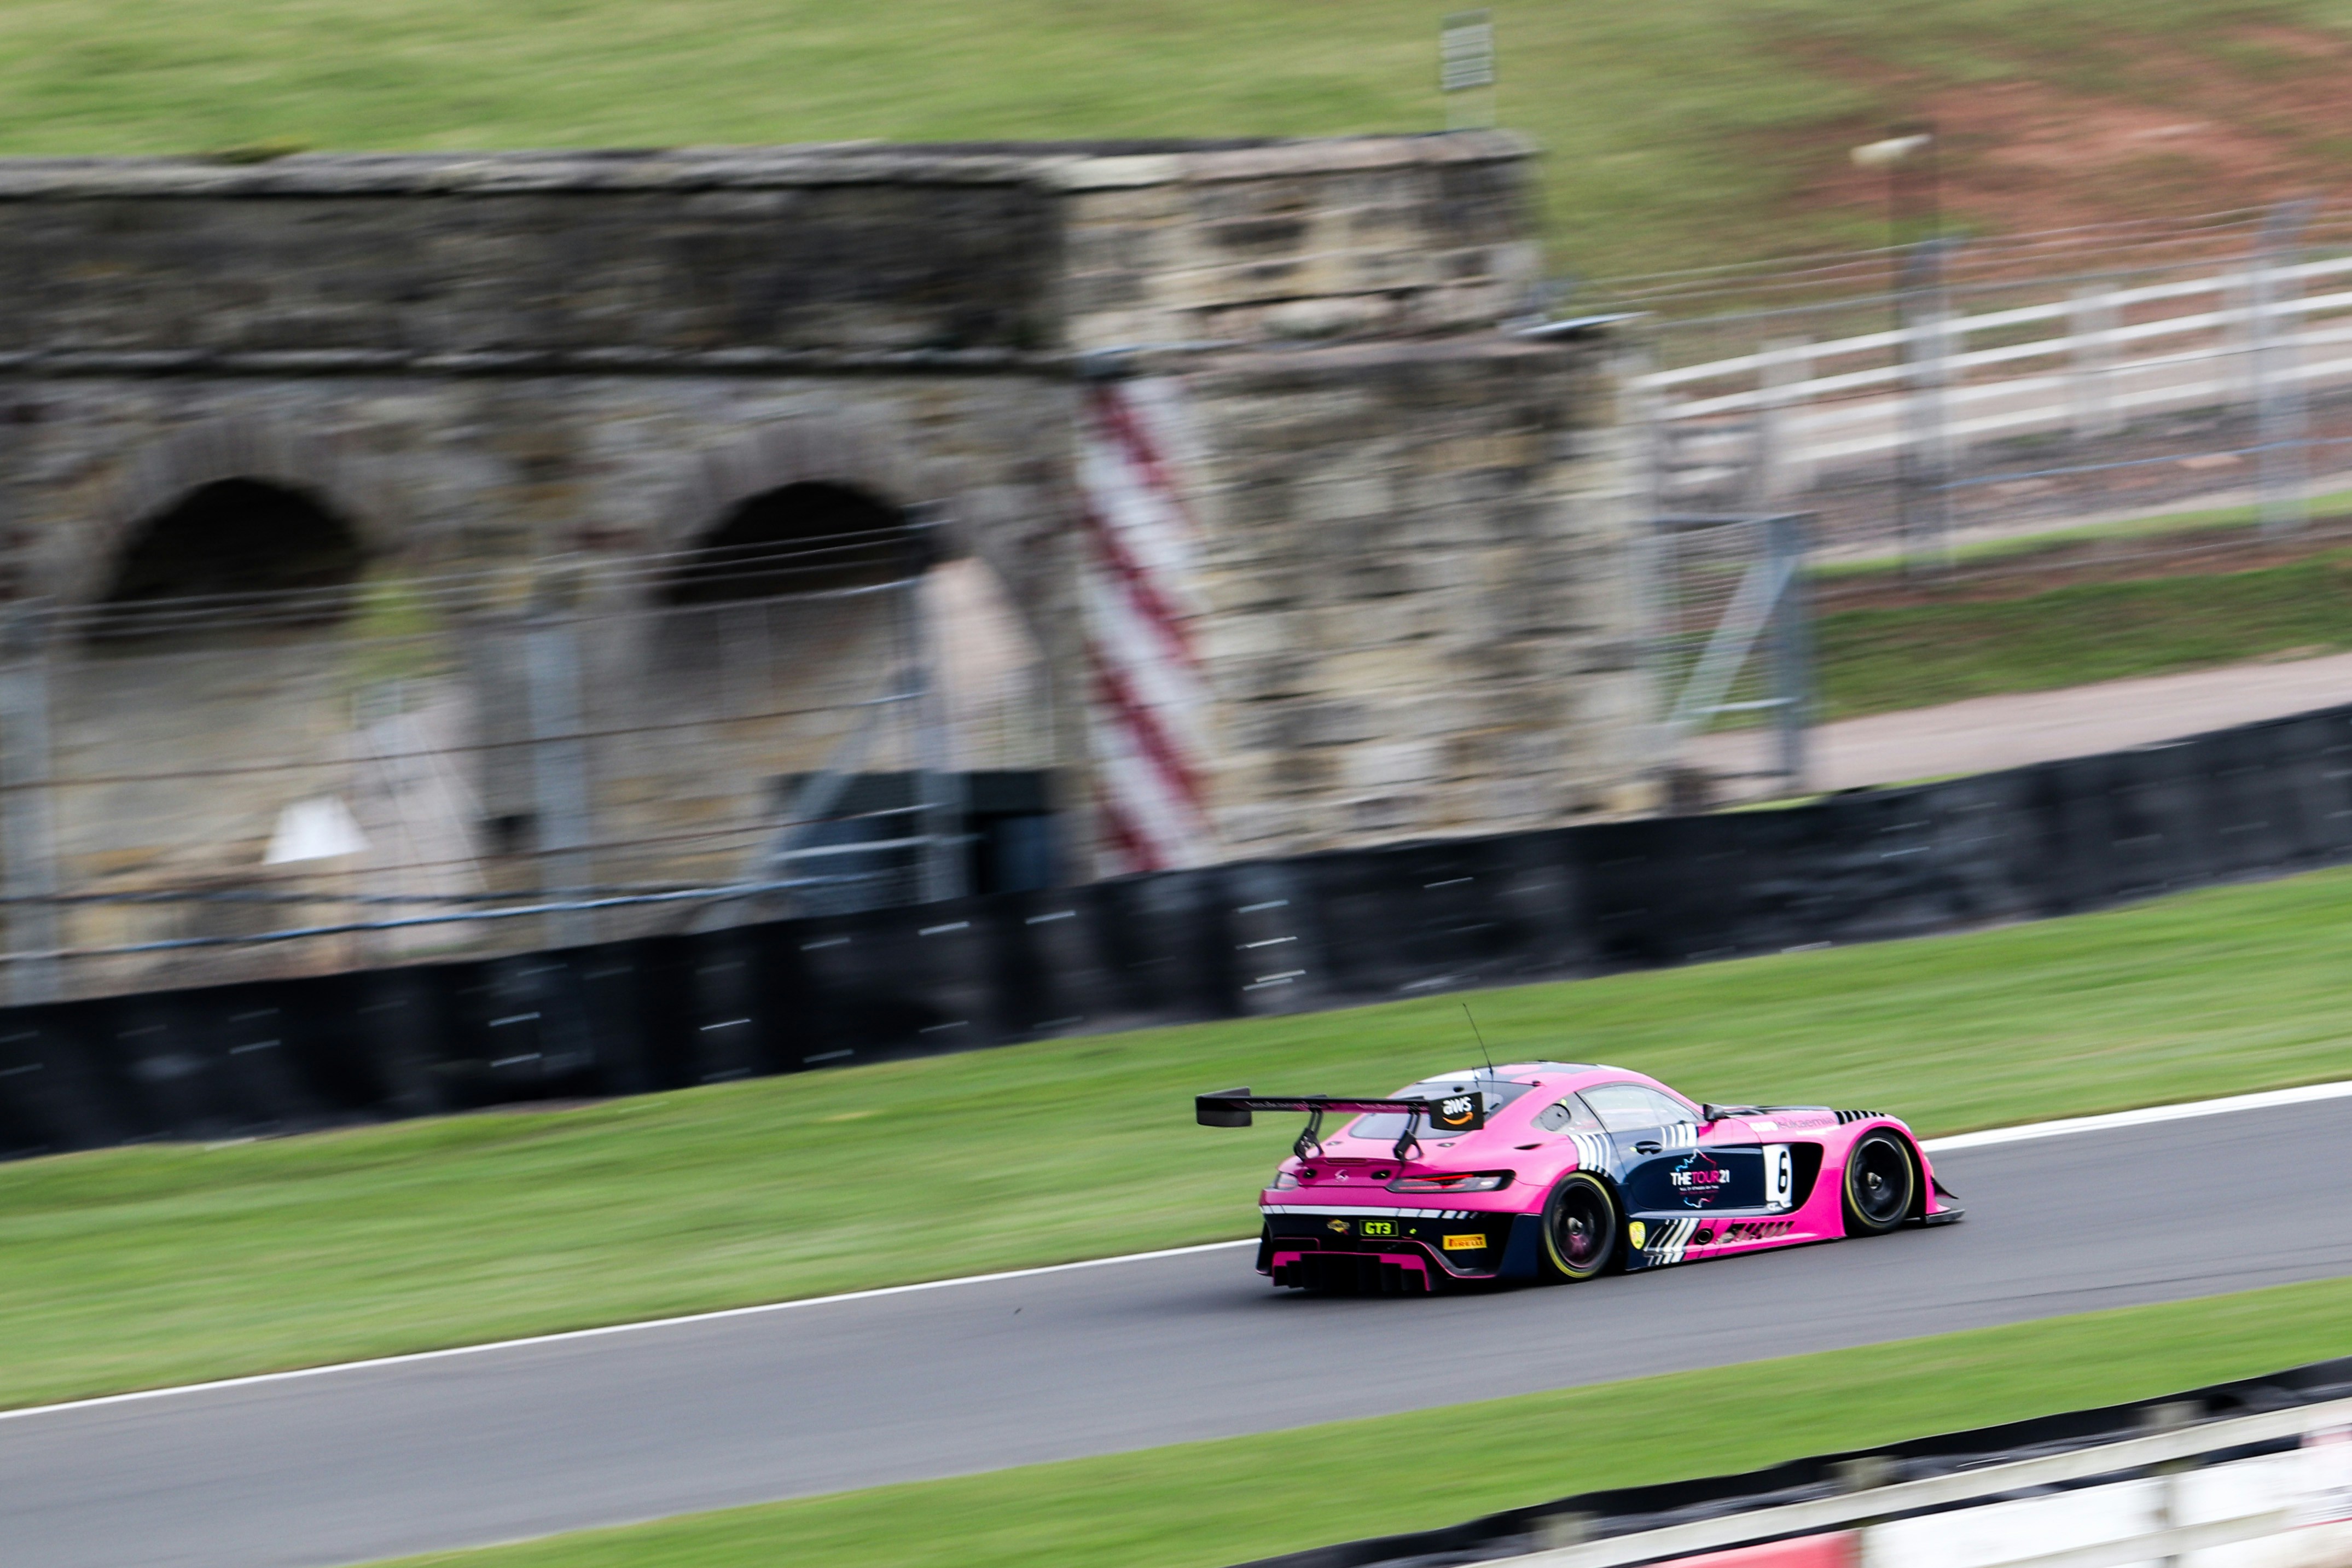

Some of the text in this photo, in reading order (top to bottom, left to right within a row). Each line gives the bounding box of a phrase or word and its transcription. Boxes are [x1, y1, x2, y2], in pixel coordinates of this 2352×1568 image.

[1443, 1096, 1472, 1115] aws
[1778, 1151, 1788, 1194] 6
[1365, 1222, 1391, 1234] GT3
